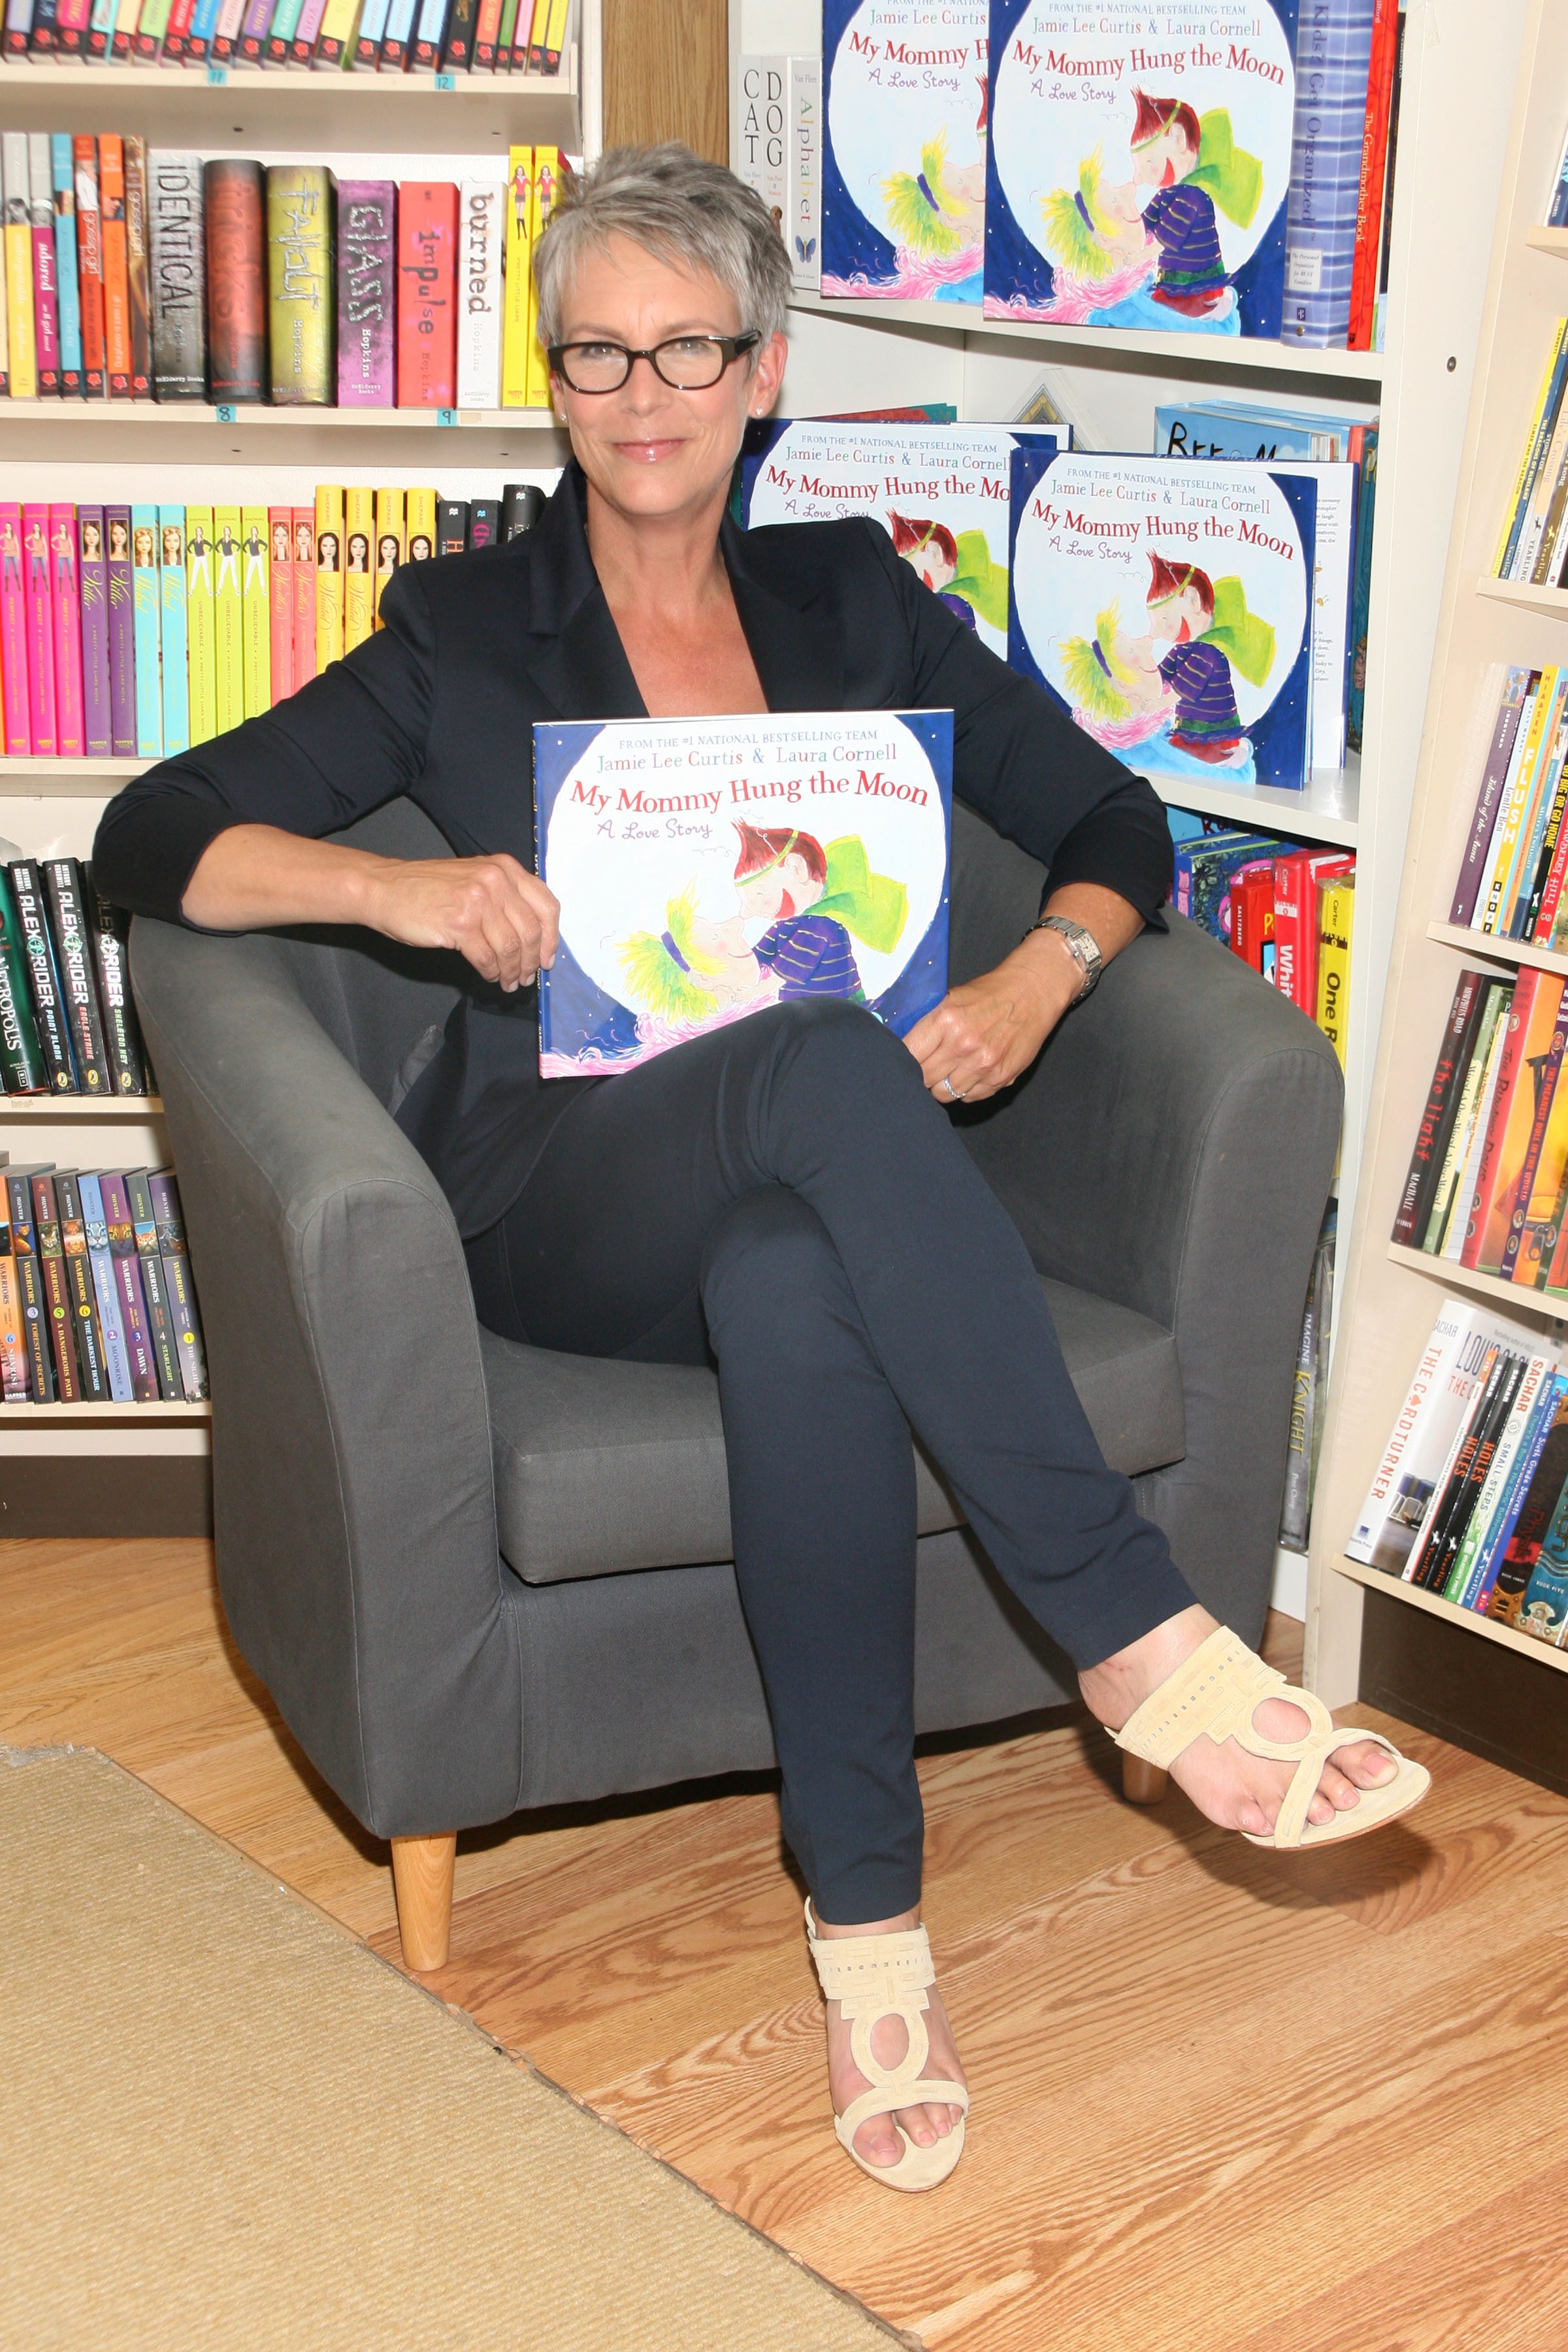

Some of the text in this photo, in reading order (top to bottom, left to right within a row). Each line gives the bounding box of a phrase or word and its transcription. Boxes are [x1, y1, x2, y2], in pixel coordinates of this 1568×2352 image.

[1033, 18, 1260, 37] Jamie Lee Curtis & Laura Cornell
[1049, 4, 1073, 12] FROM
[1076, 5, 1092, 13] THE
[1107, 5, 1154, 14] NATIONAL
[1156, 5, 1217, 16] BESTSELLING
[1220, 6, 1246, 16] TEAM
[1012, 40, 1284, 86] My Mommy Hung the Moon
[1030, 79, 1117, 104] A Love Story
[1308, 73, 1324, 106] Get
[796, 97, 814, 223] Alphabet
[1301, 117, 1322, 223] Organized
[1355, 113, 1374, 243] The Grandmother Book
[158, 165, 193, 320] IDENTICAL
[38, 242, 54, 291] adored
[402, 231, 446, 335] impulse
[468, 192, 494, 372] burned Hopkins
[294, 319, 303, 374] Hopkins
[361, 329, 371, 378] Hopkins
[220, 406, 231, 422] 8
[765, 465, 1010, 503] My Mommy Hung the Mo
[1051, 479, 1270, 515] Jamie Lee Curtis & Laura Cornell
[1030, 498, 1060, 531] My
[1062, 510, 1141, 542] Mommy
[1145, 516, 1198, 541] Hung
[1203, 517, 1233, 538] the
[1237, 519, 1294, 561] Moon
[1049, 535, 1133, 563] A Love Story
[1520, 540, 1535, 581] YEARLING
[1531, 676, 1550, 735] HIAASEN
[598, 743, 897, 774] Jamie Lee Curtis & Laura Cornell
[619, 730, 877, 749] FROM THE #1 NATIONAL BESTSELLING TEAM
[569, 770, 929, 816] My Mommy Hung the Moon
[1496, 787, 1514, 832] Gentle Ben
[1503, 748, 1535, 844] FLUSH
[1554, 795, 1566, 809] OR
[597, 818, 713, 840] A Love Story
[1469, 776, 1497, 863] Island of the Aunts
[1544, 825, 1560, 849] HOME
[1550, 809, 1562, 825] GO
[1544, 877, 1559, 907] HILL
[19, 895, 63, 1060] ALEX RIDER POINT BLANK
[58, 892, 94, 1060] ALEX RIDER EAGLE STRIKE
[1325, 972, 1340, 1020] One
[104, 955, 128, 1064] RIDER SKELETON KEY
[1520, 1066, 1556, 1201] THE MEANEST DOLL IN THE WORLD
[65, 1194, 74, 1218] HUNTER
[111, 1194, 120, 1218] HUNTER
[136, 1193, 144, 1218] HUNTER
[161, 1192, 170, 1218] HUNTER
[24, 1262, 35, 1305] WARRIORS
[48, 1262, 61, 1304] WARRIORS
[74, 1259, 87, 1302] WARRIORS
[97, 1260, 110, 1303] WARRIORS
[122, 1260, 135, 1303] WARRIORS
[147, 1261, 160, 1303] WARRIORS
[172, 1262, 186, 1305] WARRIORS
[84, 1320, 100, 1391] THE DARKEST HOUR
[111, 1345, 123, 1386] MOONRISE
[136, 1348, 148, 1375] DAWN
[161, 1344, 173, 1382] STARLIGHT
[1289, 1313, 1312, 1458] IMAGINE KNIGHT
[1503, 1369, 1519, 1403] SACHAR
[1538, 1380, 1552, 1407] SACHAR
[1454, 1364, 1503, 1477] SACHAR HOLES
[1480, 1360, 1543, 1511] SACHAR SMALL STEPS
[1471, 1441, 1495, 1483] HOLES
[1511, 1401, 1558, 1516] SACHAR Sixth Grade Secrets
